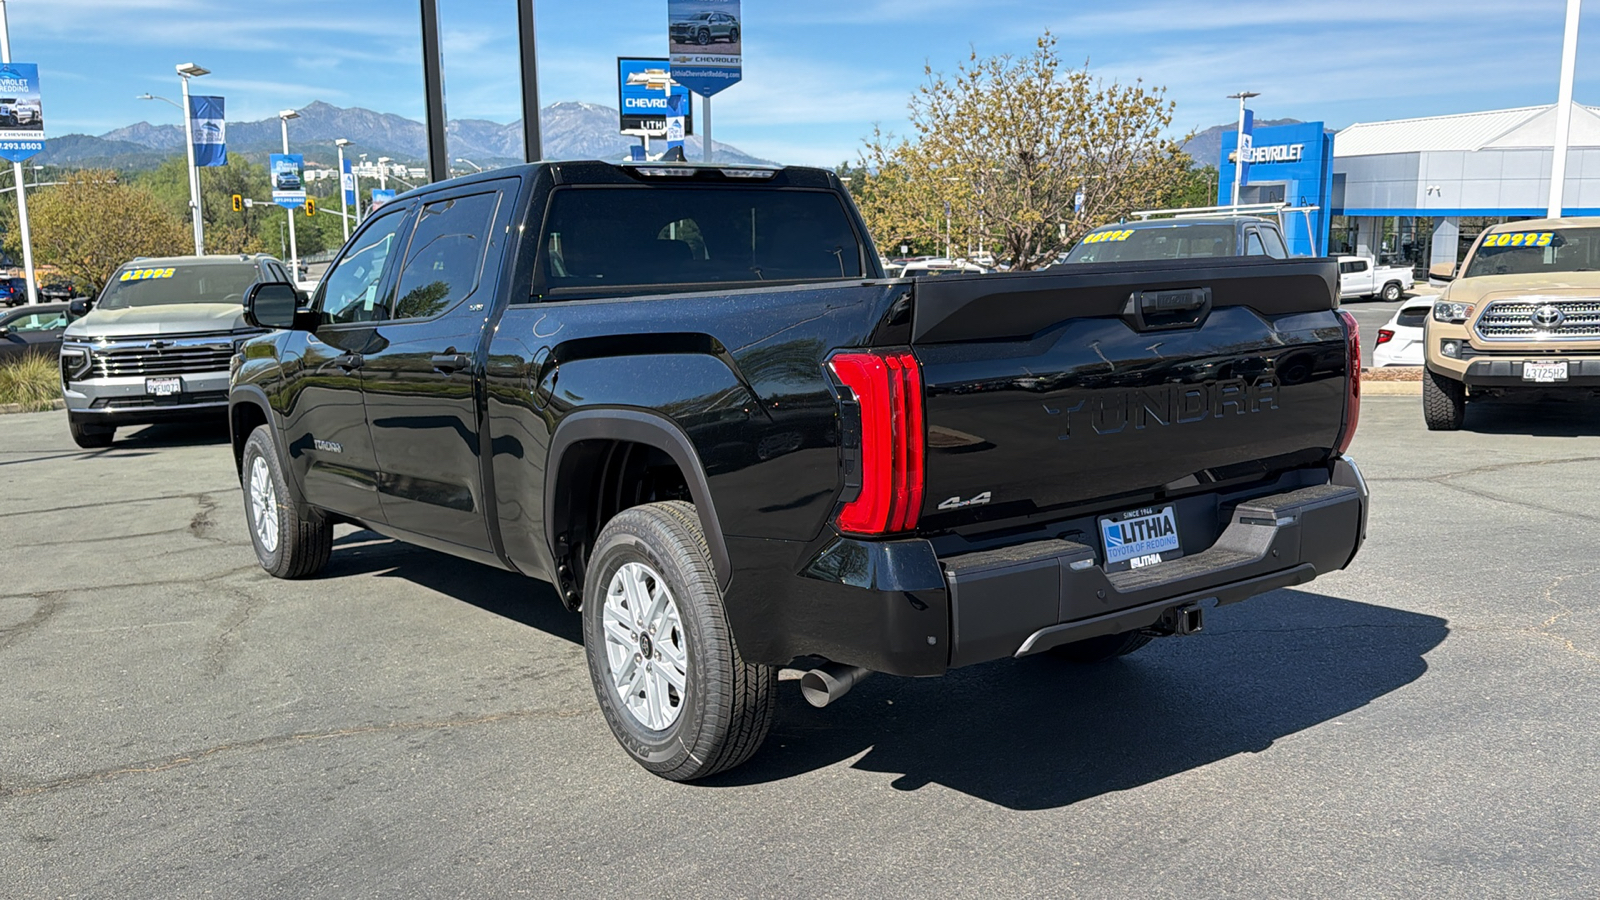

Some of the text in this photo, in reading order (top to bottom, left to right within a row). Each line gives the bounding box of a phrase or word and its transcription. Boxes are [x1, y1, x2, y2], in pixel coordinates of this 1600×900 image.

[672, 70, 740, 79] LithiaChevroletRedding.com
[625, 98, 668, 108] CHEVRO
[640, 121, 666, 129] LITHI
[1483, 233, 1554, 247] 20995
[1042, 374, 1280, 440] TUNDRA
[1123, 510, 1139, 519] SINCE
[1120, 515, 1175, 545] LITHIA
[1108, 535, 1177, 558] TOYOTA OF REDDING
[1138, 553, 1162, 568] LITHIA
